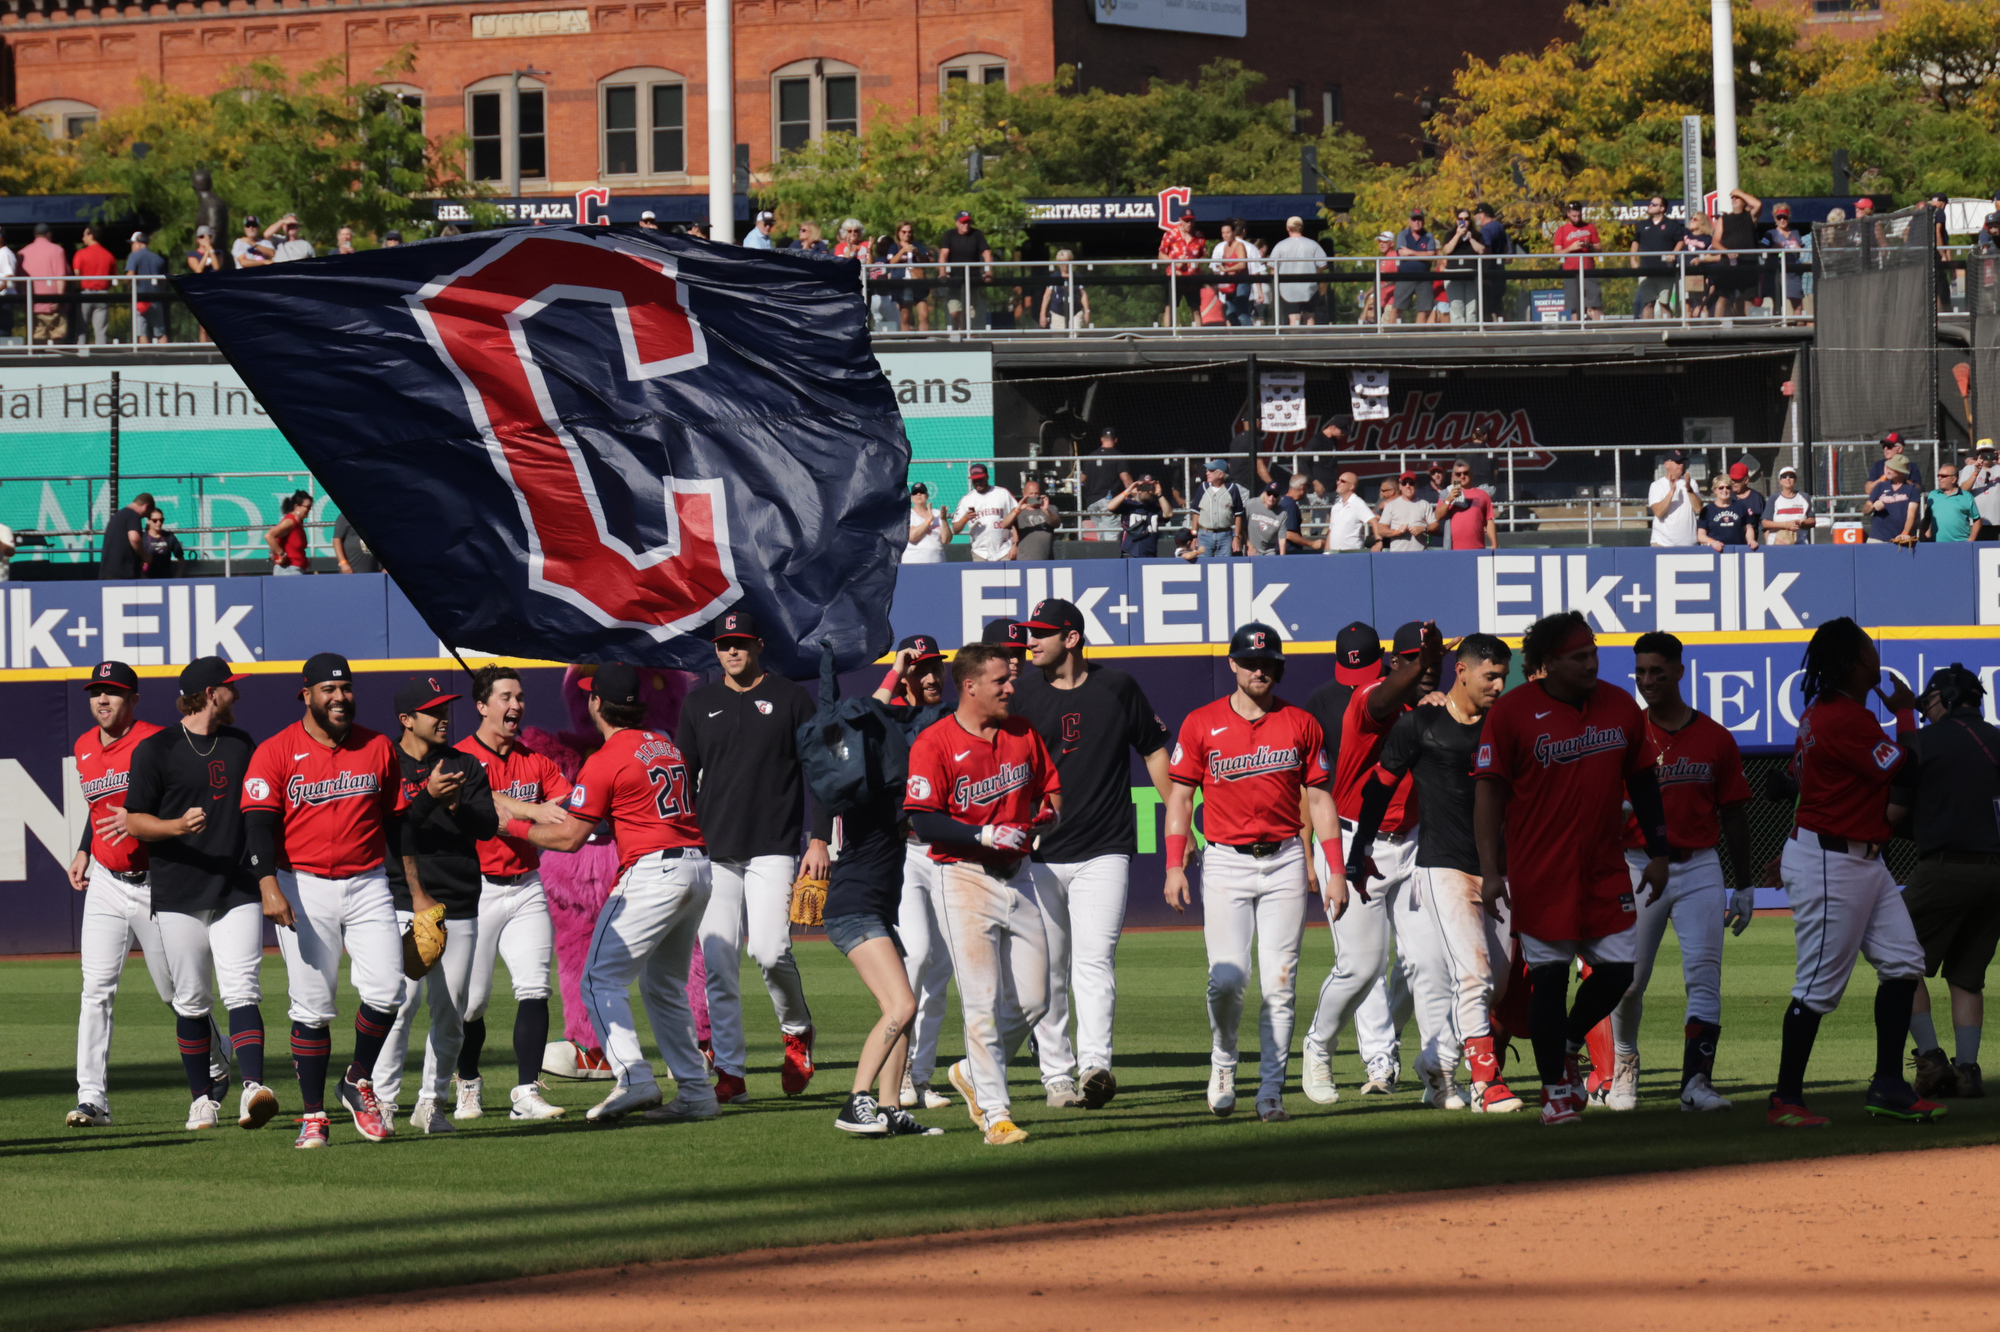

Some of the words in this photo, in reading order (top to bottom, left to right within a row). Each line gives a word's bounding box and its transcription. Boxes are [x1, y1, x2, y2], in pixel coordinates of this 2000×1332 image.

[479, 10, 587, 35] UTICA
[520, 203, 573, 219] PLAZA
[576, 186, 610, 226] C
[1104, 203, 1156, 218] PLAZA
[1158, 186, 1191, 231] C
[1690, 196, 1698, 213] GHT
[63, 382, 197, 419] Health
[1843, 529, 1856, 543] G
[0, 585, 256, 668] k+Elk
[634, 740, 682, 766] HEDGES
[1209, 745, 1302, 783] Guardians
[1534, 725, 1627, 769] Guardians
[80, 768, 130, 801] uardian
[287, 770, 381, 808] Guardians
[1655, 757, 1714, 787] ardians
[647, 764, 692, 820] 27
